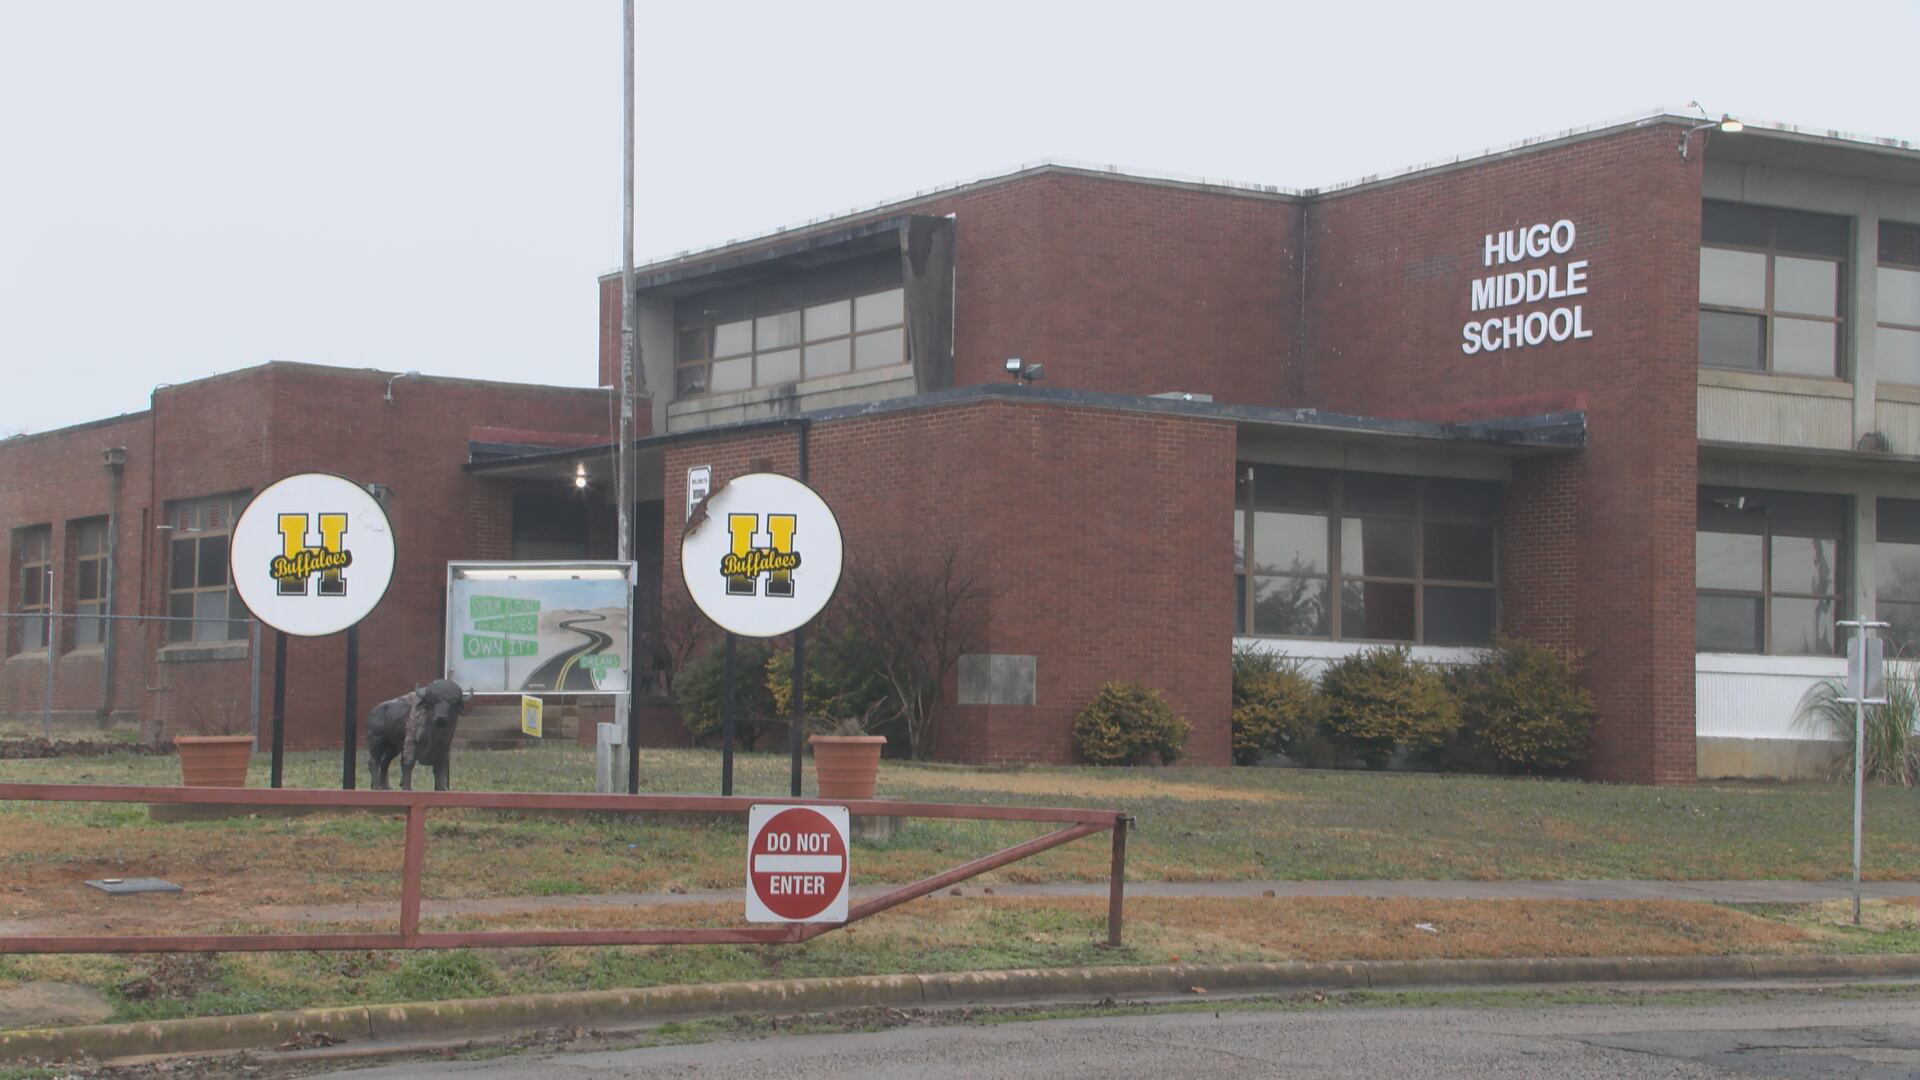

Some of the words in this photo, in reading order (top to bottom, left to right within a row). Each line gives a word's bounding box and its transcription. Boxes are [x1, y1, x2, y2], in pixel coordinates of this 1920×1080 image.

[1484, 219, 1576, 267] HUGO
[1471, 260, 1589, 312] MIDDLE
[1462, 305, 1593, 355] SCHOOL
[272, 550, 350, 579] Buffaloes
[277, 513, 348, 597] H
[722, 550, 799, 578] Buffaloes
[726, 513, 797, 598] H
[468, 638, 503, 657] OWN
[767, 832, 791, 852] DO
[796, 832, 831, 852] NOT
[770, 875, 825, 895] ENTER
